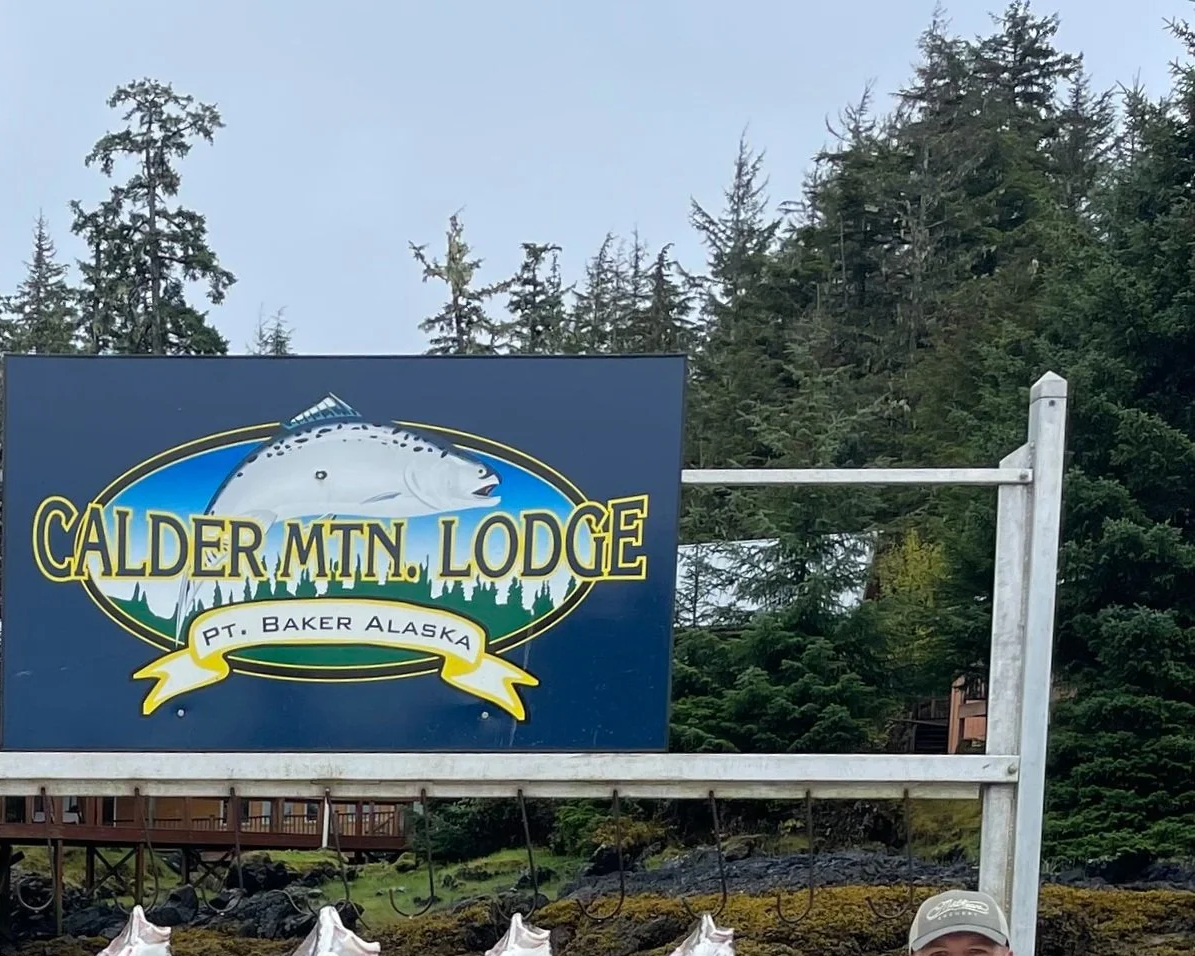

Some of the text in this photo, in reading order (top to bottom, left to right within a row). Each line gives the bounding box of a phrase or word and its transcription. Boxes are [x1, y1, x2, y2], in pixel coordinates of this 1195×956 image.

[33, 495, 649, 582] CALDER MTN. LODGE
[202, 615, 471, 650] PT. BAKER ALASKA
